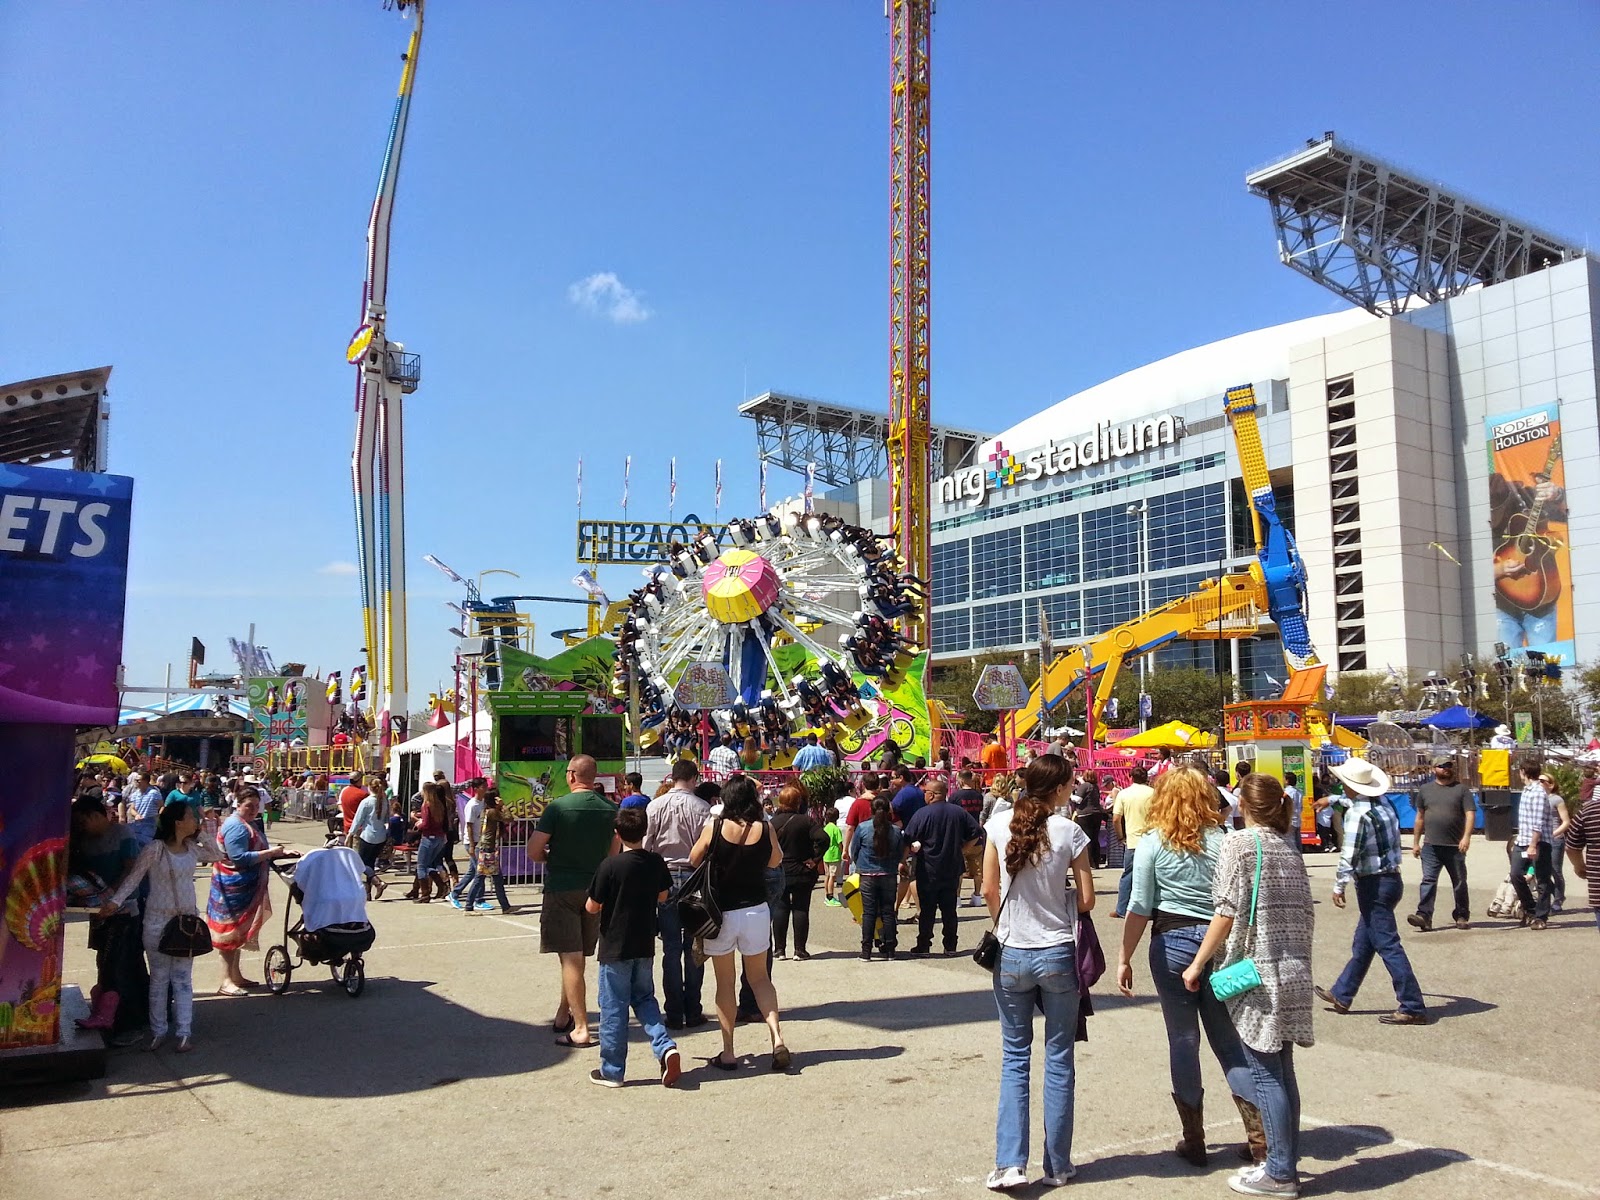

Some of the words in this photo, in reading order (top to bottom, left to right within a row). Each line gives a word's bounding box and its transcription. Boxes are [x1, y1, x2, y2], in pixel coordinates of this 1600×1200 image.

[1494, 426, 1550, 451] HOUSTON
[938, 465, 986, 507] nrg
[1024, 413, 1177, 481] stadium
[0, 494, 111, 558] ETS
[686, 664, 727, 686] FREE
[678, 683, 731, 707] STYLE
[270, 719, 296, 735] BIG
